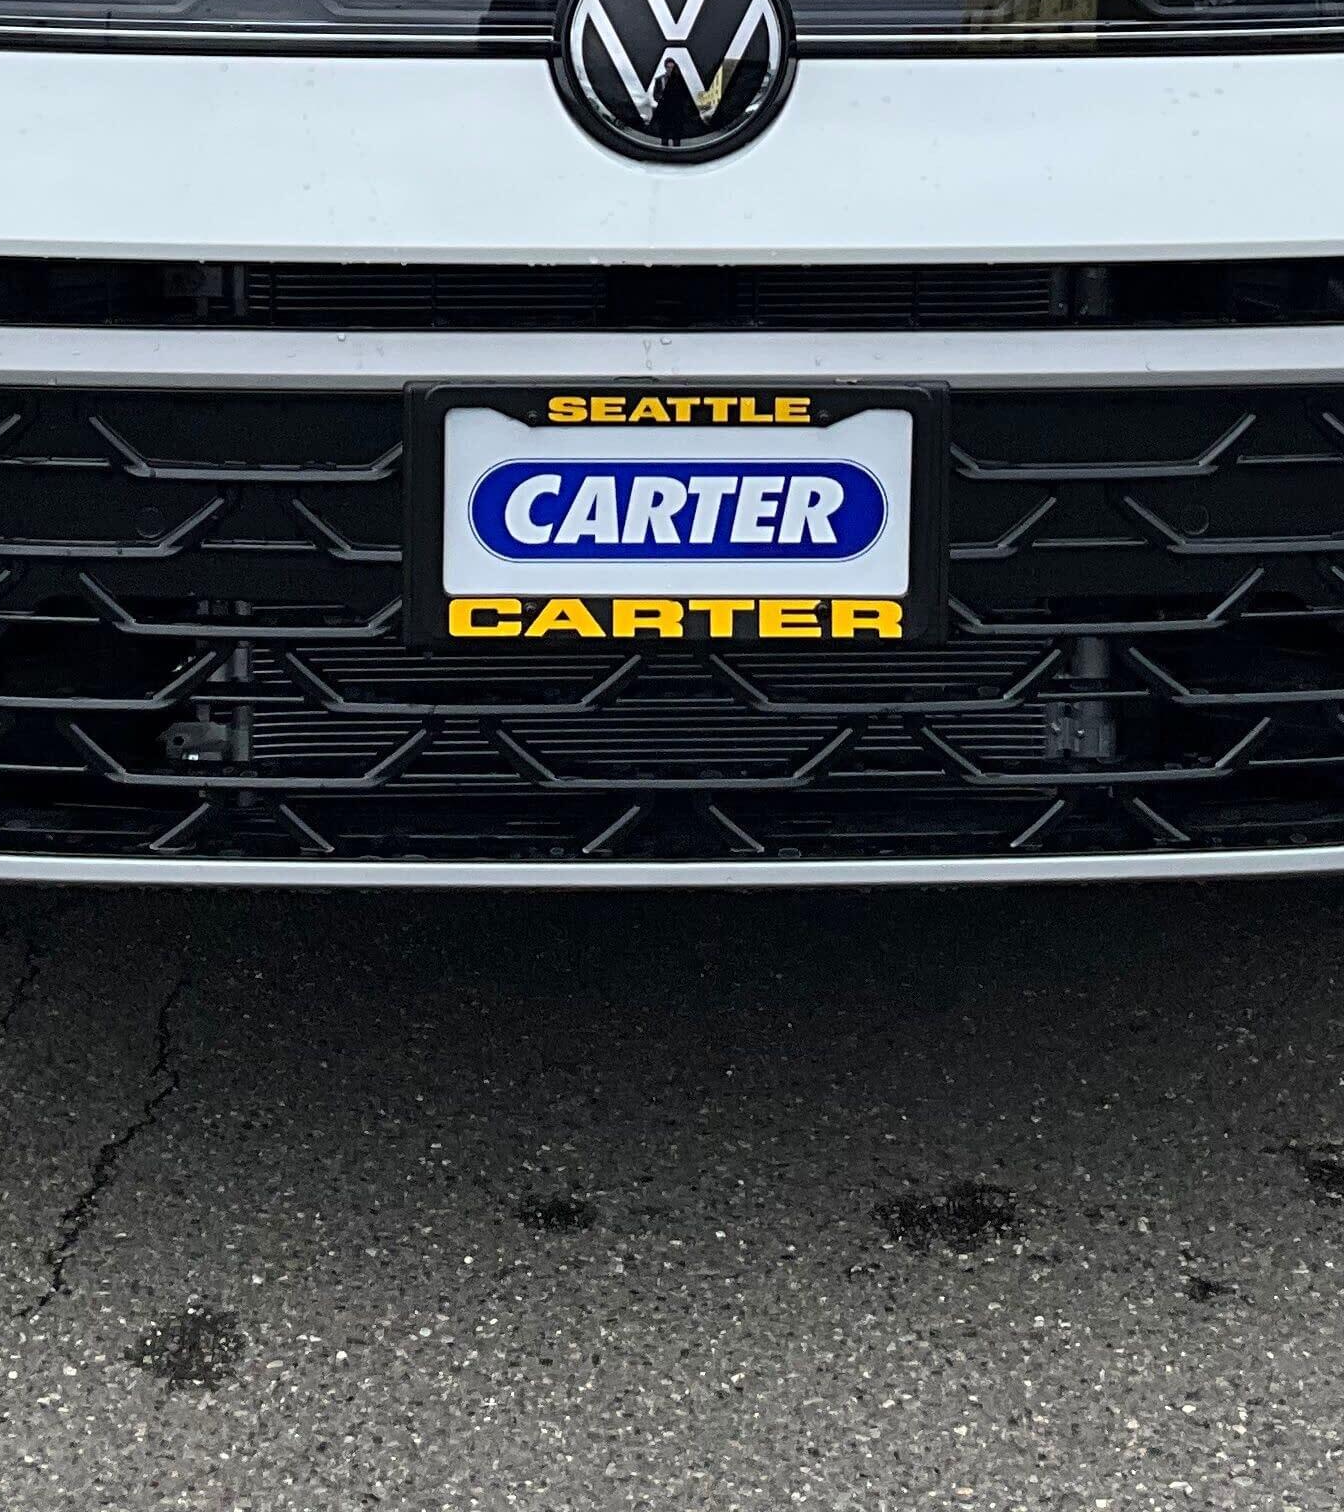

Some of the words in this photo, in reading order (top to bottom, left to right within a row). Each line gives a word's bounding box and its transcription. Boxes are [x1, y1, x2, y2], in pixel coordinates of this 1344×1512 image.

[548, 396, 811, 423] SEATTLE
[504, 474, 844, 545] CARTER
[449, 599, 902, 638] CARTER
